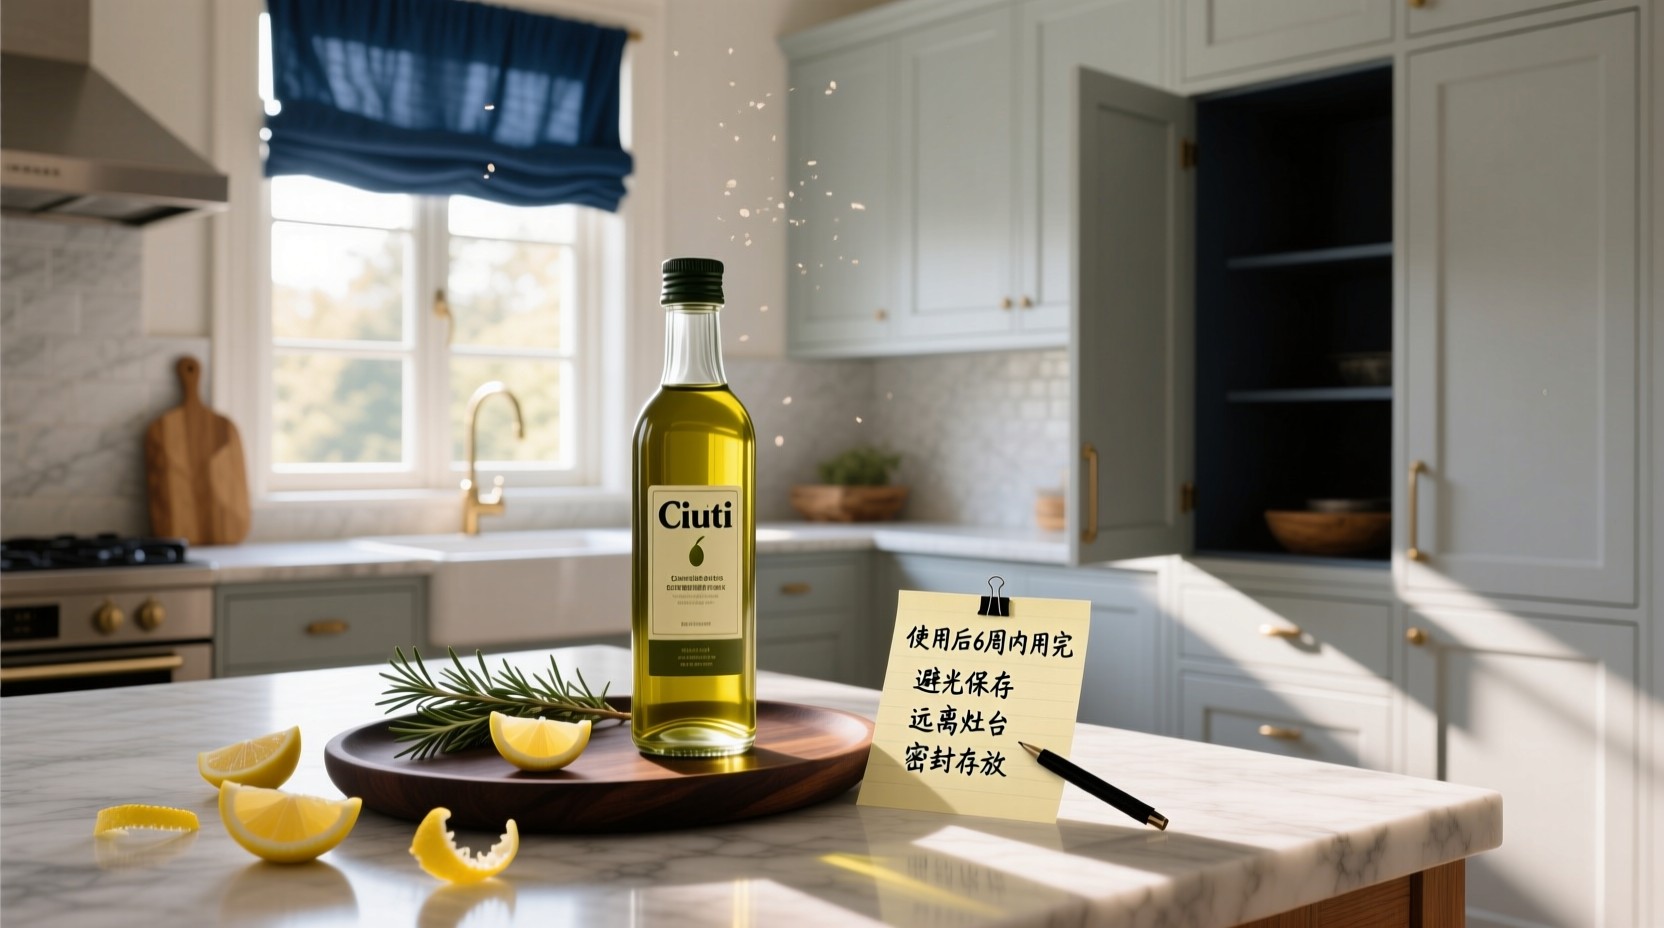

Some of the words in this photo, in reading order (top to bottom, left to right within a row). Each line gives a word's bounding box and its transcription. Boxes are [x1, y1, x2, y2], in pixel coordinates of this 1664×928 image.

[658, 500, 733, 529] Ciuti
[906, 624, 1074, 658] 使用后6周内用完
[912, 666, 1014, 700] 避光保存
[908, 704, 1007, 737] 远离灶台
[905, 741, 1007, 777] 密封存放
